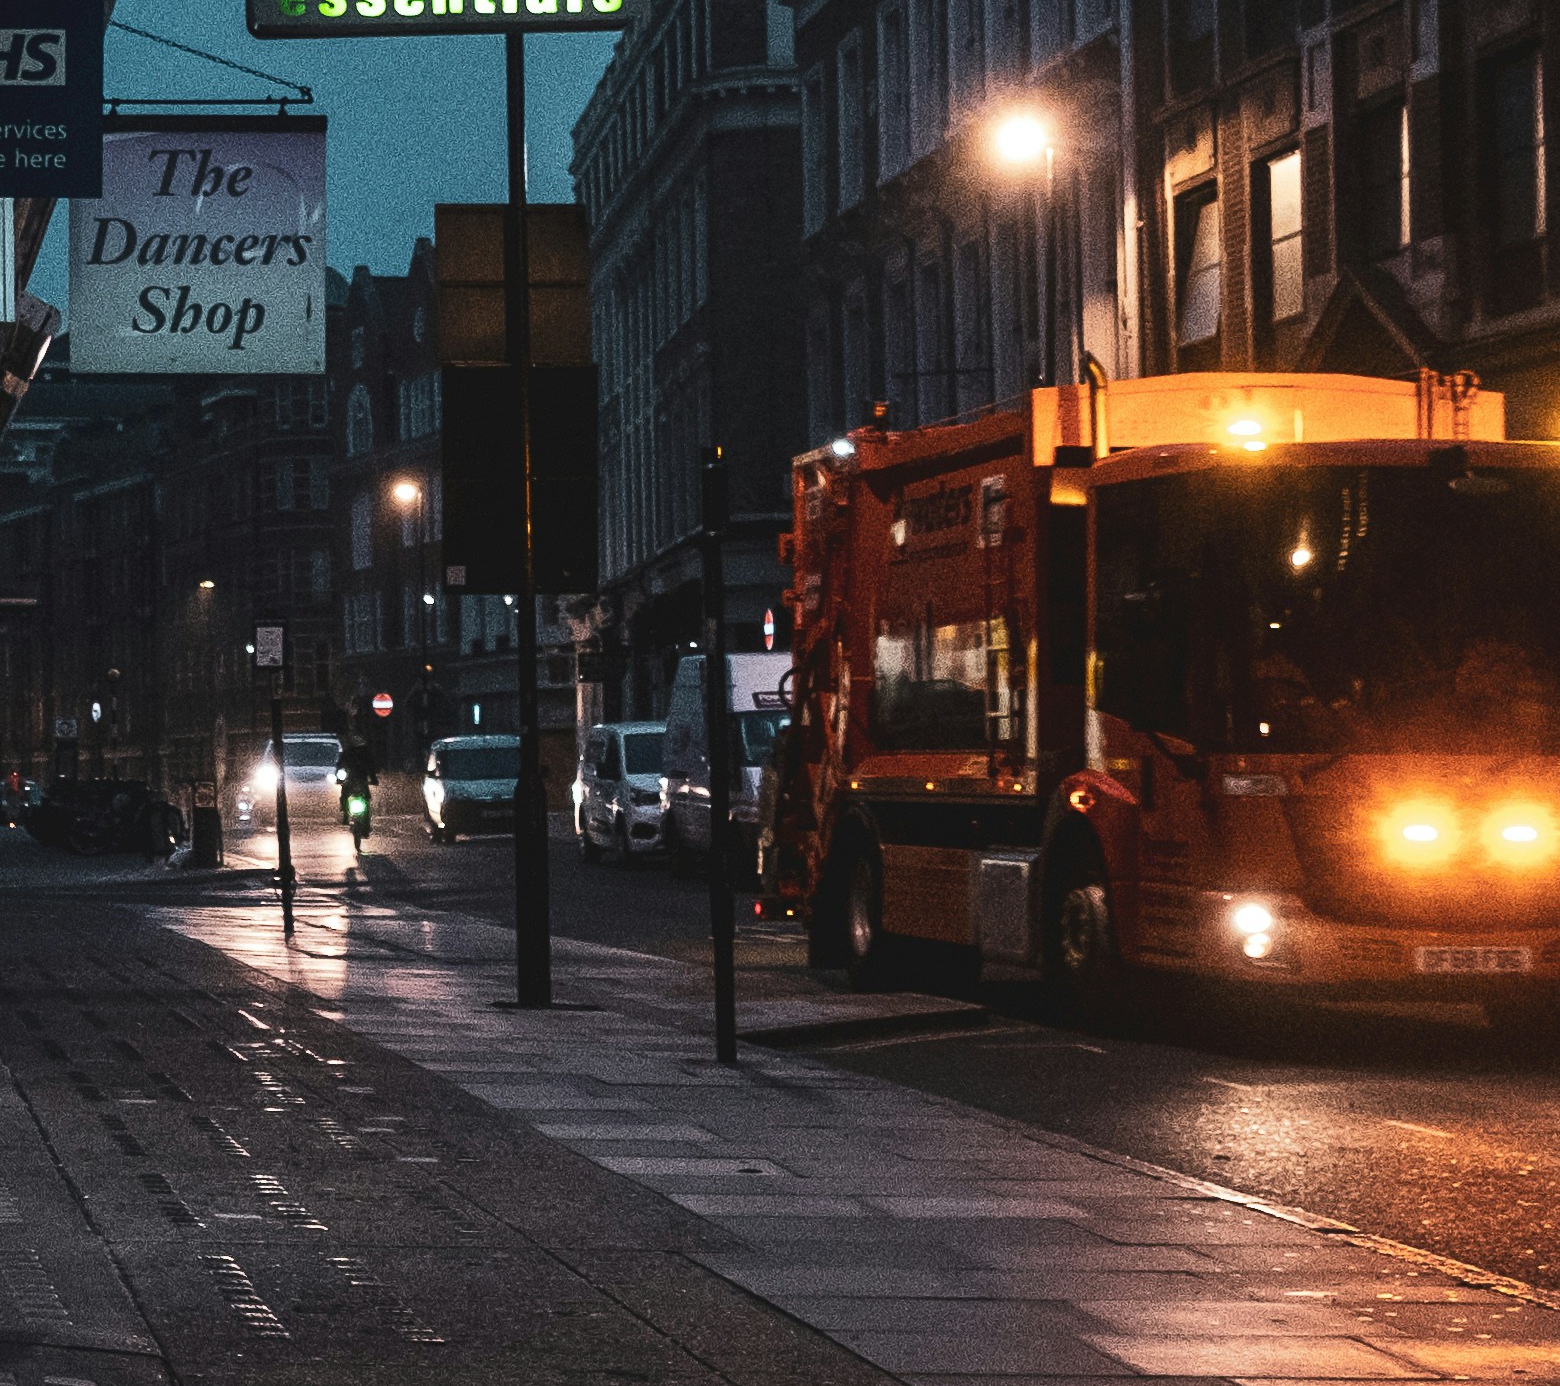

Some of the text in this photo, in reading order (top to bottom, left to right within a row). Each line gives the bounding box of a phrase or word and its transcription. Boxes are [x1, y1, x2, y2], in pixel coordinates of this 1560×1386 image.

[15, 147, 67, 169] here
[148, 149, 254, 198] The
[85, 216, 314, 267] Dancers
[132, 285, 267, 351] Shop
